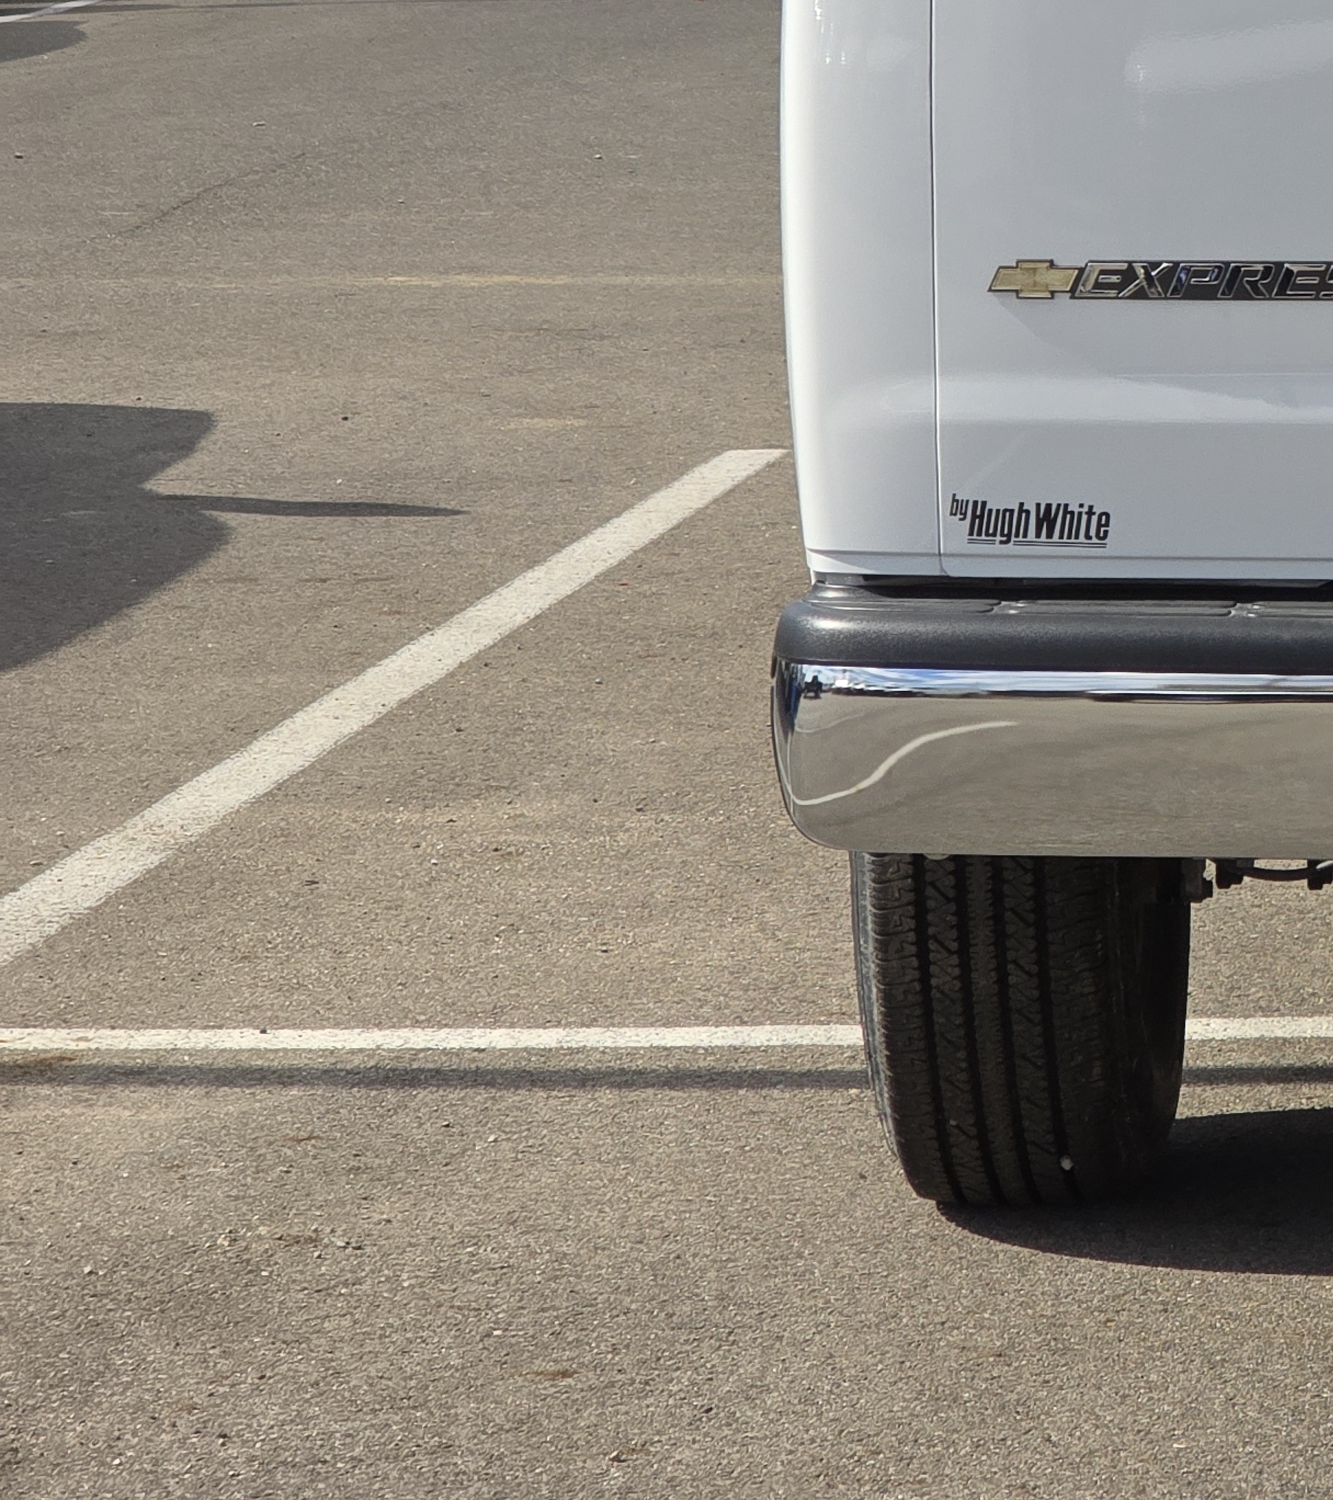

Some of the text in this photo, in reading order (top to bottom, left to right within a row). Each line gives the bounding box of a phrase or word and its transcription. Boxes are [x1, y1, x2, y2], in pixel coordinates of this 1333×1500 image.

[949, 493, 1111, 545] by Hugh White
